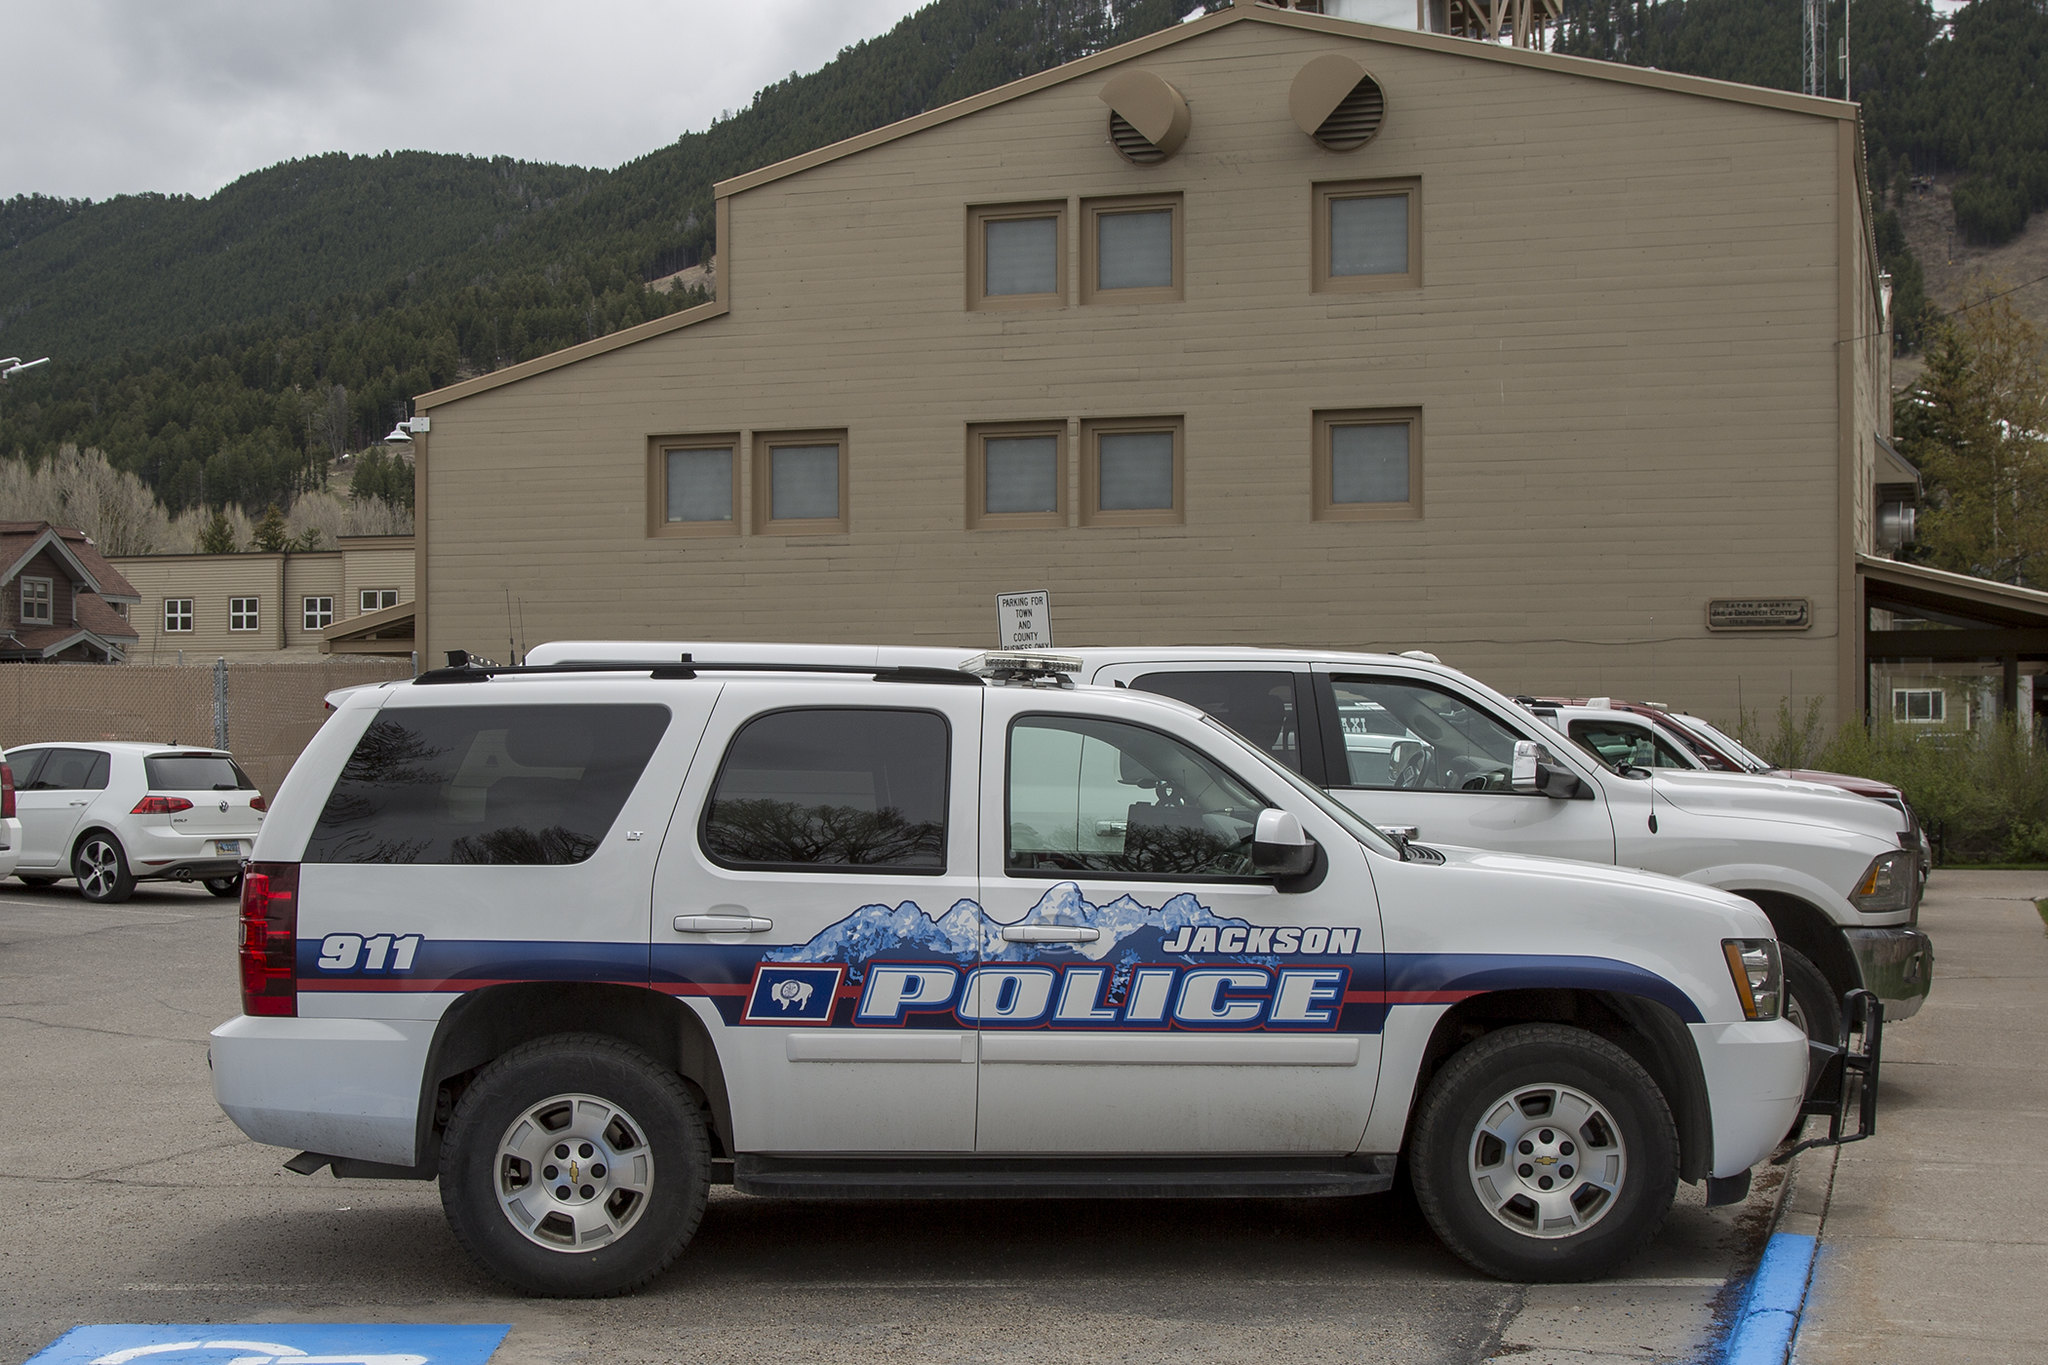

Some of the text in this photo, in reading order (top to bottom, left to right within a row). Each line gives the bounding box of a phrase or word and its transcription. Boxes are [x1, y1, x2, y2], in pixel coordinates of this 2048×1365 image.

[1002, 596, 1043, 607] PARKING FOR
[1015, 609, 1032, 618] TOWN
[1018, 620, 1031, 629] AND
[1013, 632, 1038, 642] COUNTY
[1341, 718, 1367, 733] AXI
[626, 831, 644, 841] LT
[1162, 926, 1359, 955] JACKSON
[317, 934, 421, 972] 911
[857, 965, 1346, 1024] POLICE
